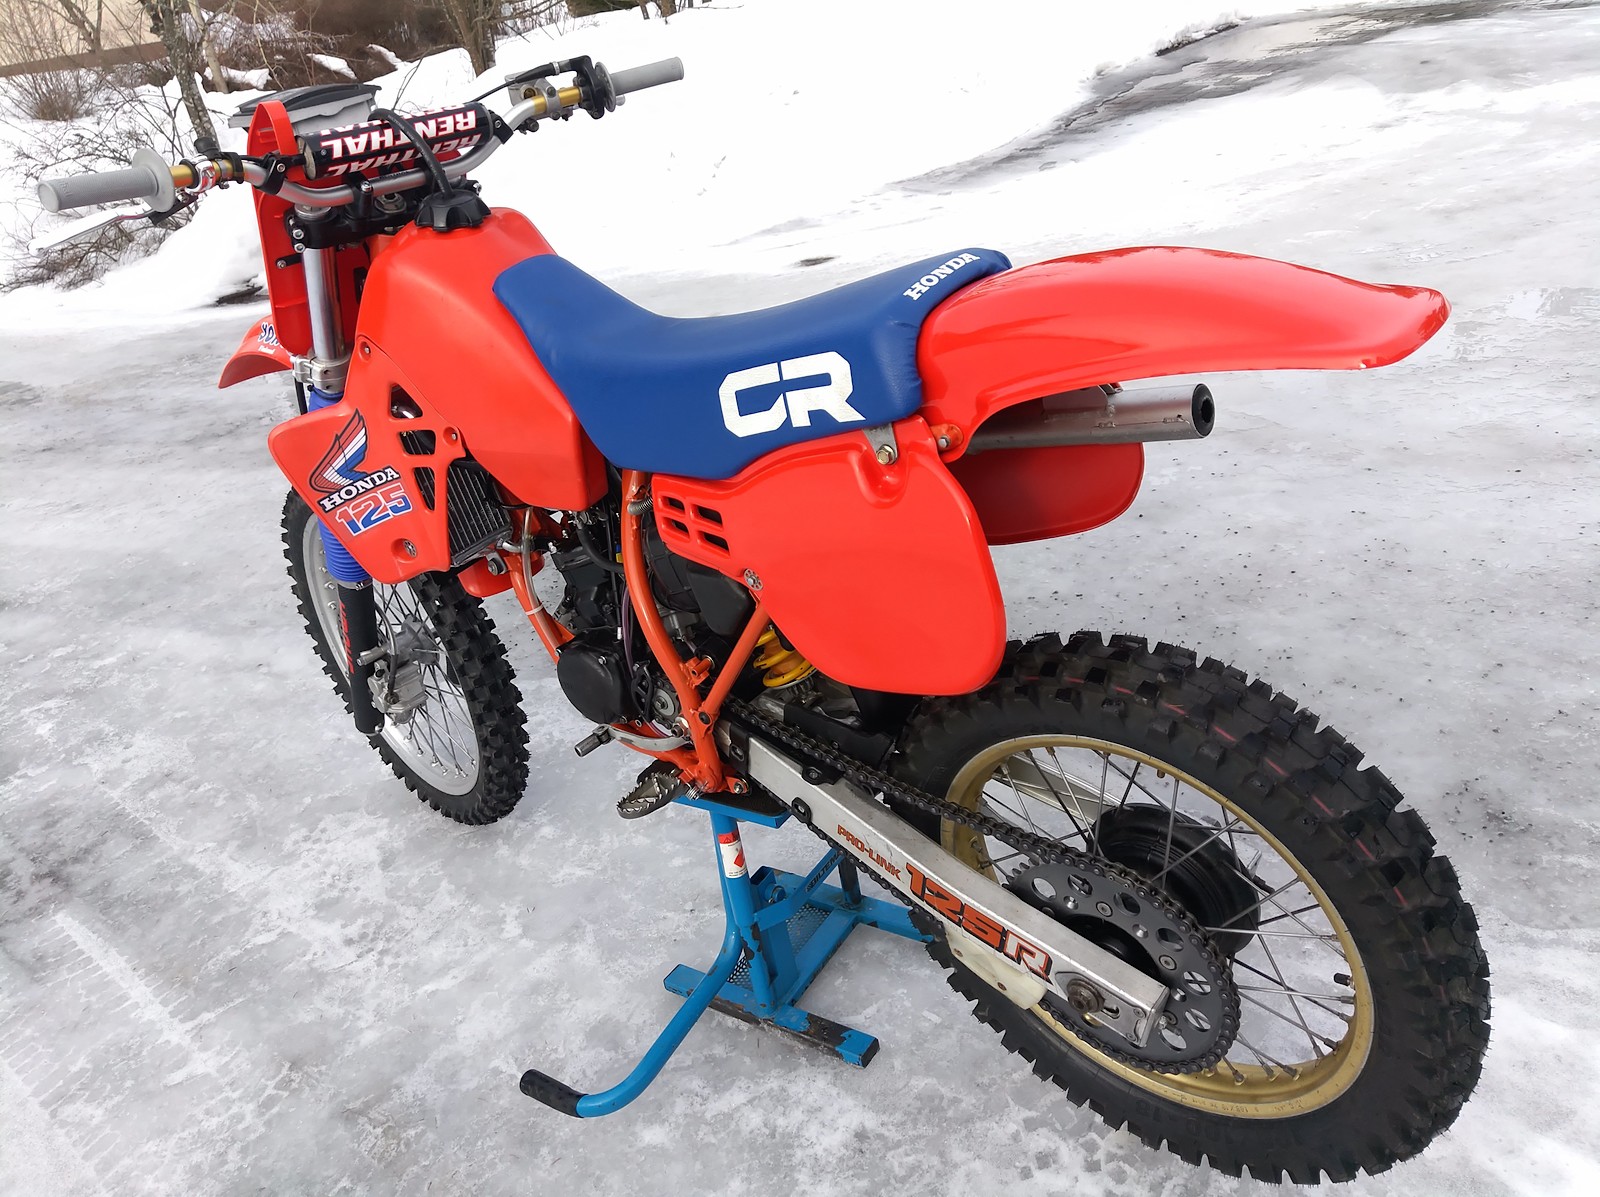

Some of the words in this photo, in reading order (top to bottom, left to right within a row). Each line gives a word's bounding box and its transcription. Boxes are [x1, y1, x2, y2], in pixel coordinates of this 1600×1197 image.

[320, 110, 477, 160] RENTHAL
[903, 252, 980, 301] HONDA
[718, 351, 866, 438] CR
[320, 467, 400, 511] HONDA
[335, 483, 412, 536] 125
[837, 824, 901, 881] PRO-LINK
[906, 862, 1054, 986] 125R
